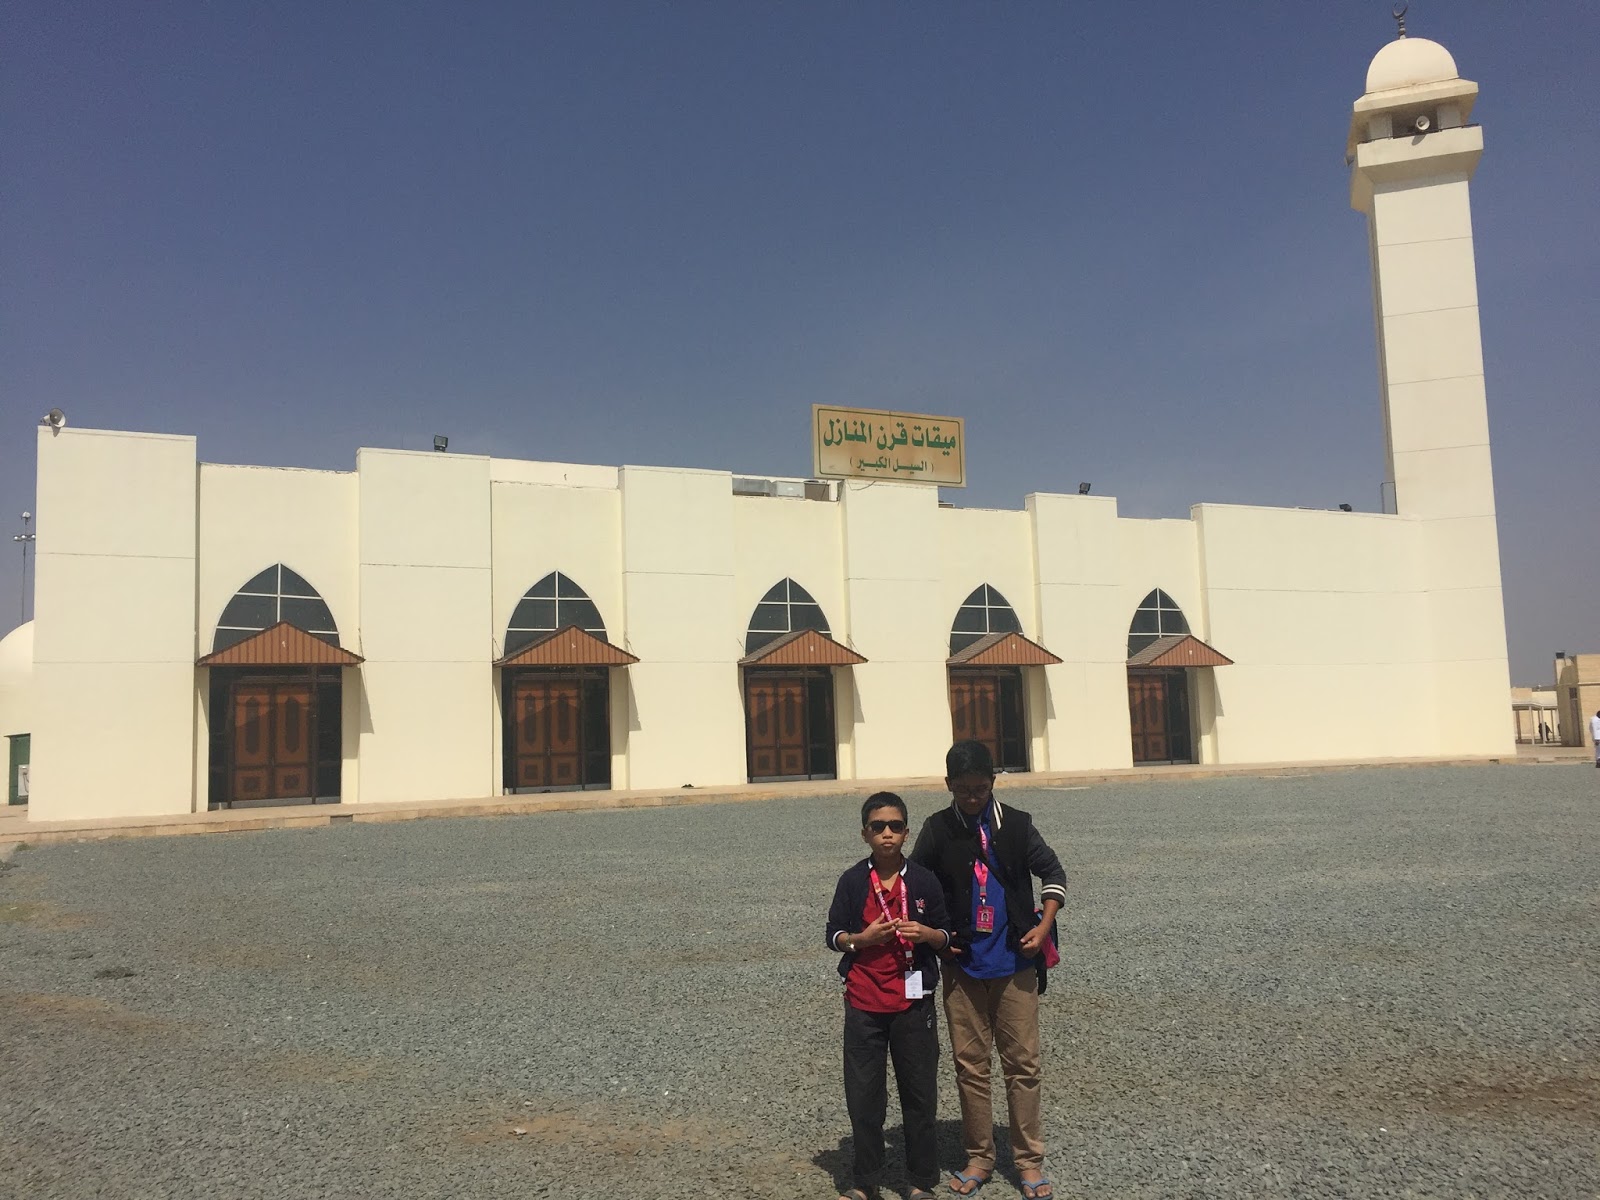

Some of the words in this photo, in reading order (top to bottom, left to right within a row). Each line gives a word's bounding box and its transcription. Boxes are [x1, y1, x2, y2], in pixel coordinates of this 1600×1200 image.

[823, 418, 872, 446] المنازل
[876, 422, 908, 451] قرن
[911, 425, 956, 456] ميقات
